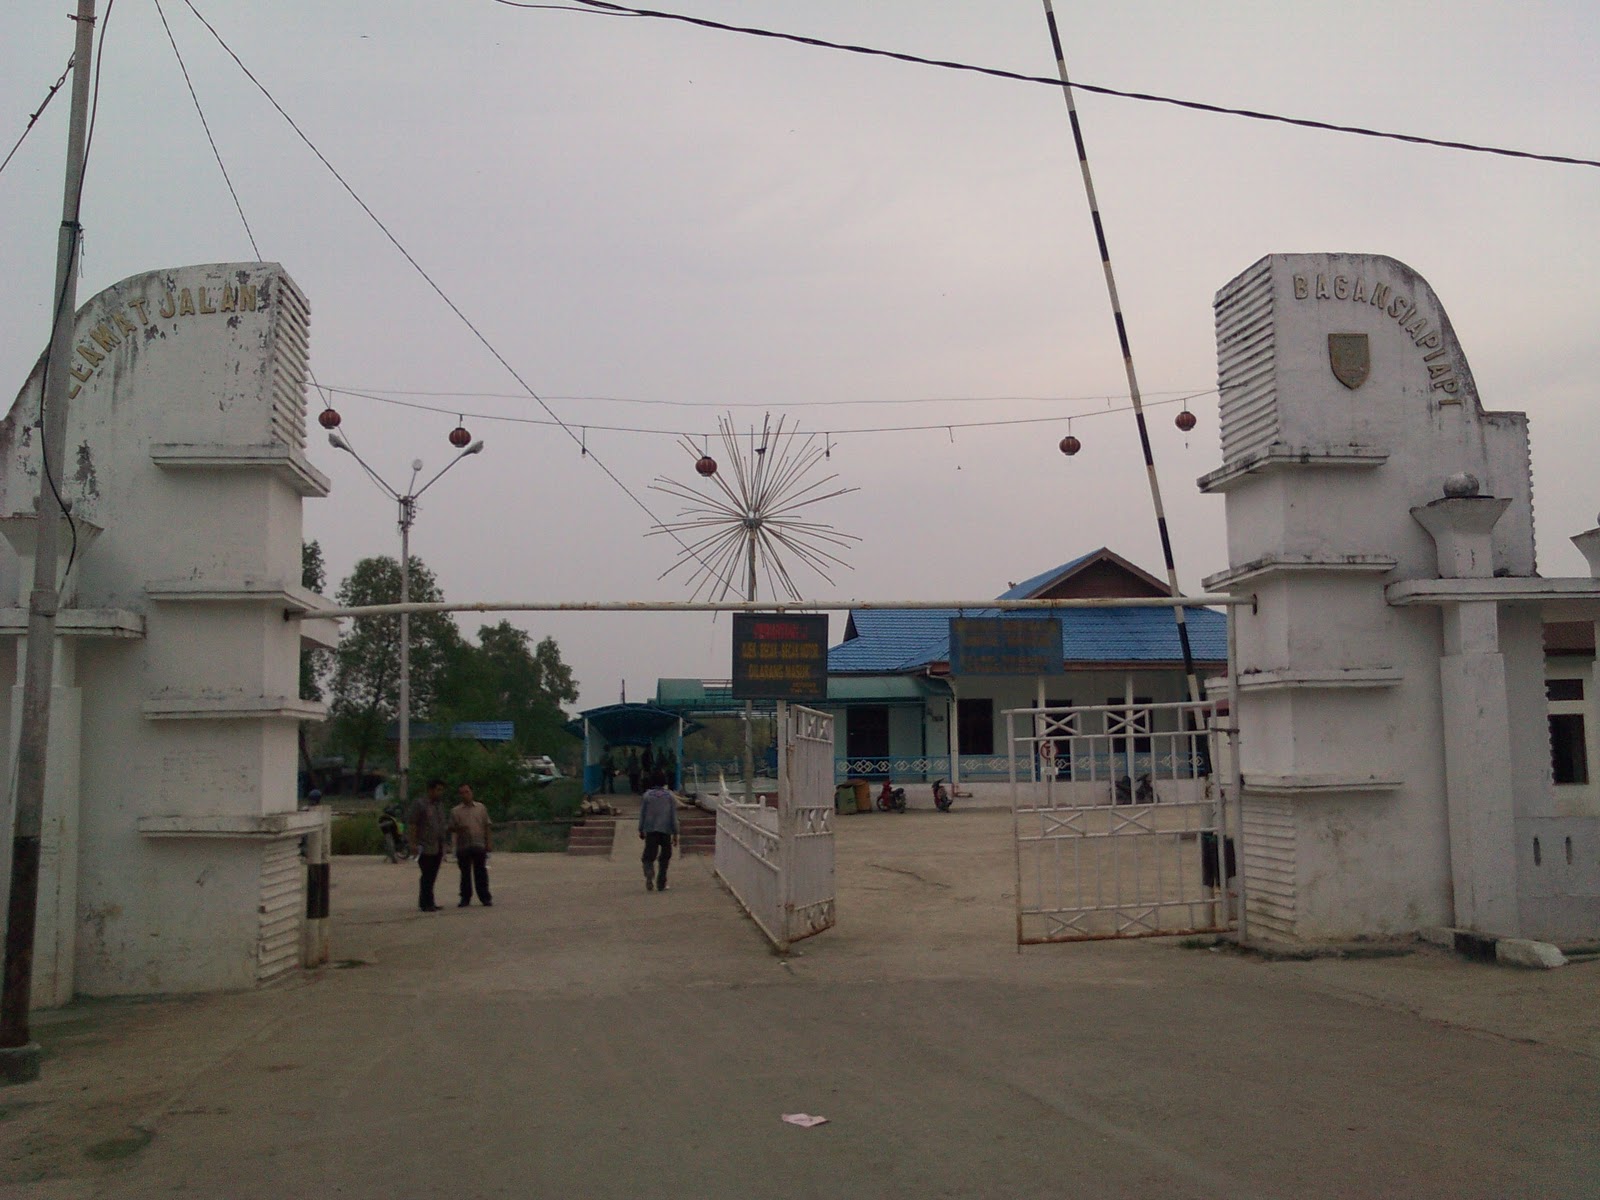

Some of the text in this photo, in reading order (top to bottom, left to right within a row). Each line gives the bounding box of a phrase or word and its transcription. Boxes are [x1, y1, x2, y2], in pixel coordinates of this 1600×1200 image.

[68, 284, 258, 400] LAMAT JALAN
[1293, 275, 1462, 410] BAGANSIAPIAPI
